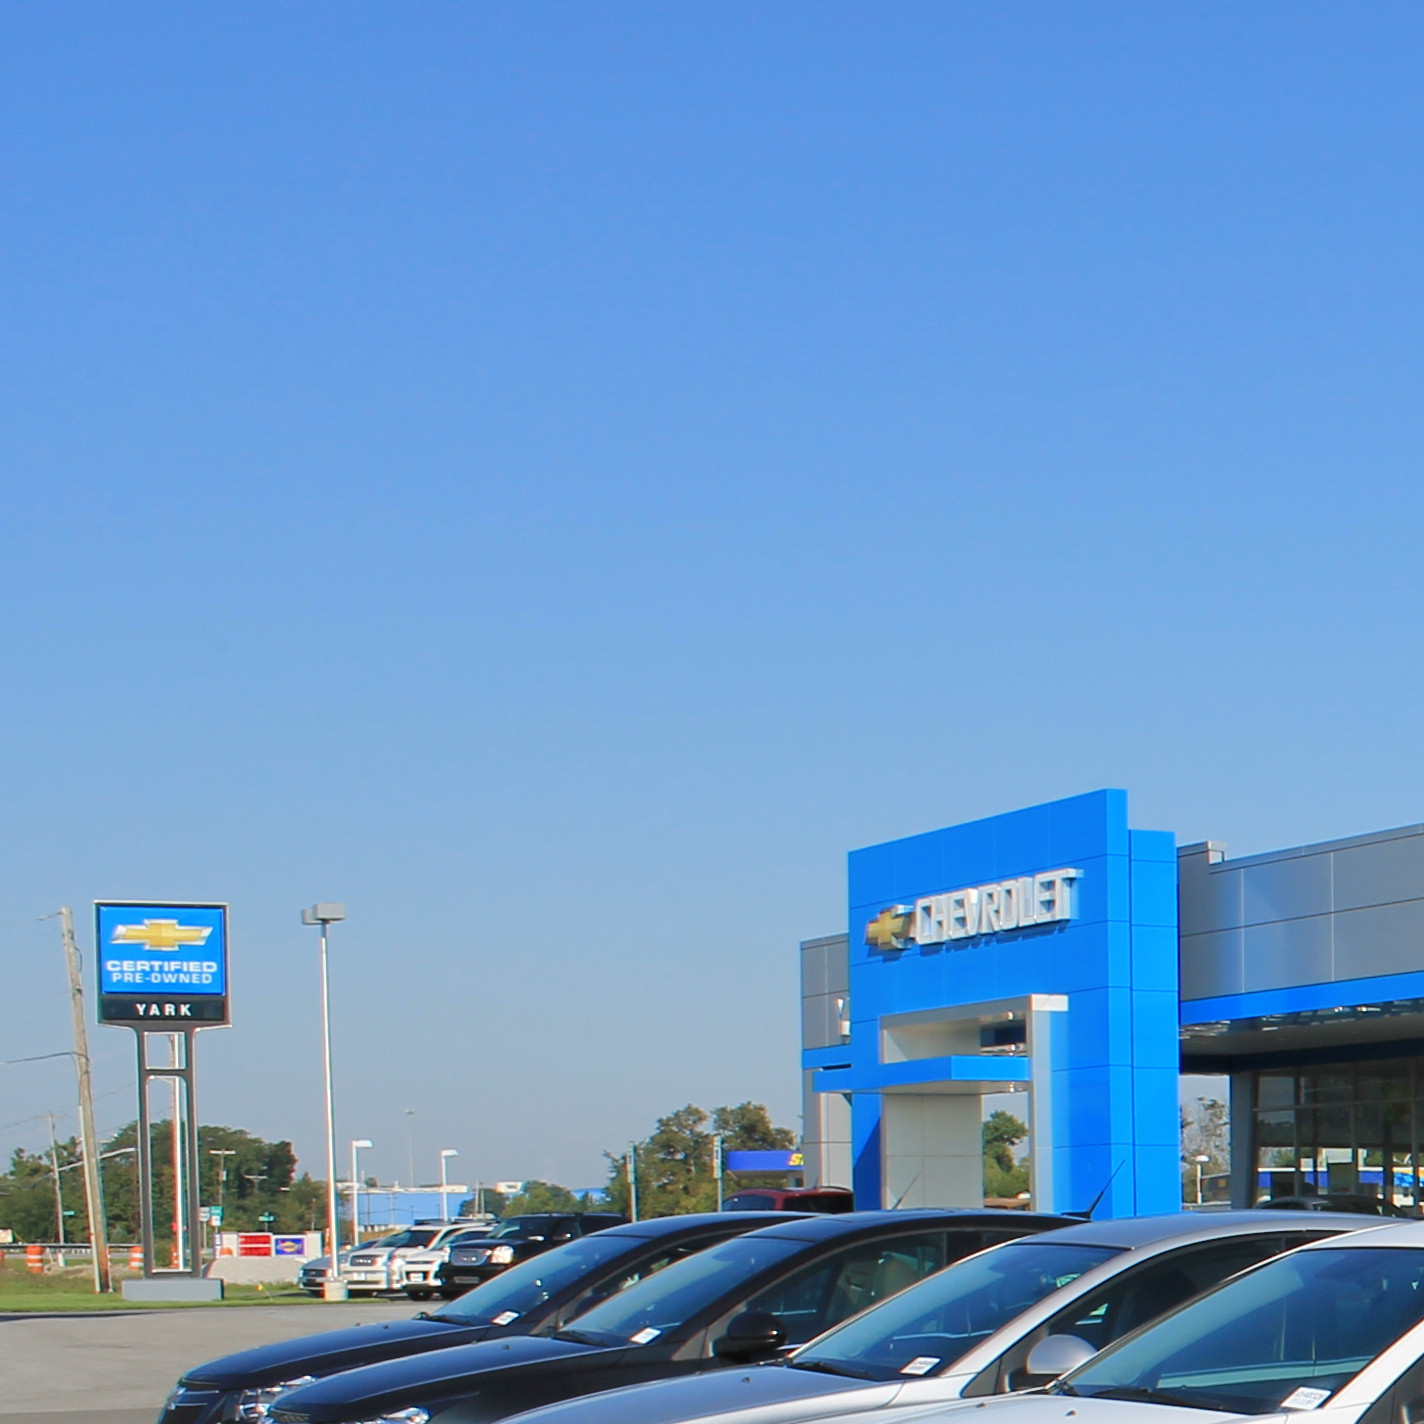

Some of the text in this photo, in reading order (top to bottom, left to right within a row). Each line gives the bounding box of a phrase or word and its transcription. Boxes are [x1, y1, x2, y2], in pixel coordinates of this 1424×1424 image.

[914, 868, 1084, 946] CHEVROLET
[106, 960, 218, 972] CERTIFIED
[112, 972, 213, 984] PRE-OWNED
[135, 1003, 192, 1016] YARK
